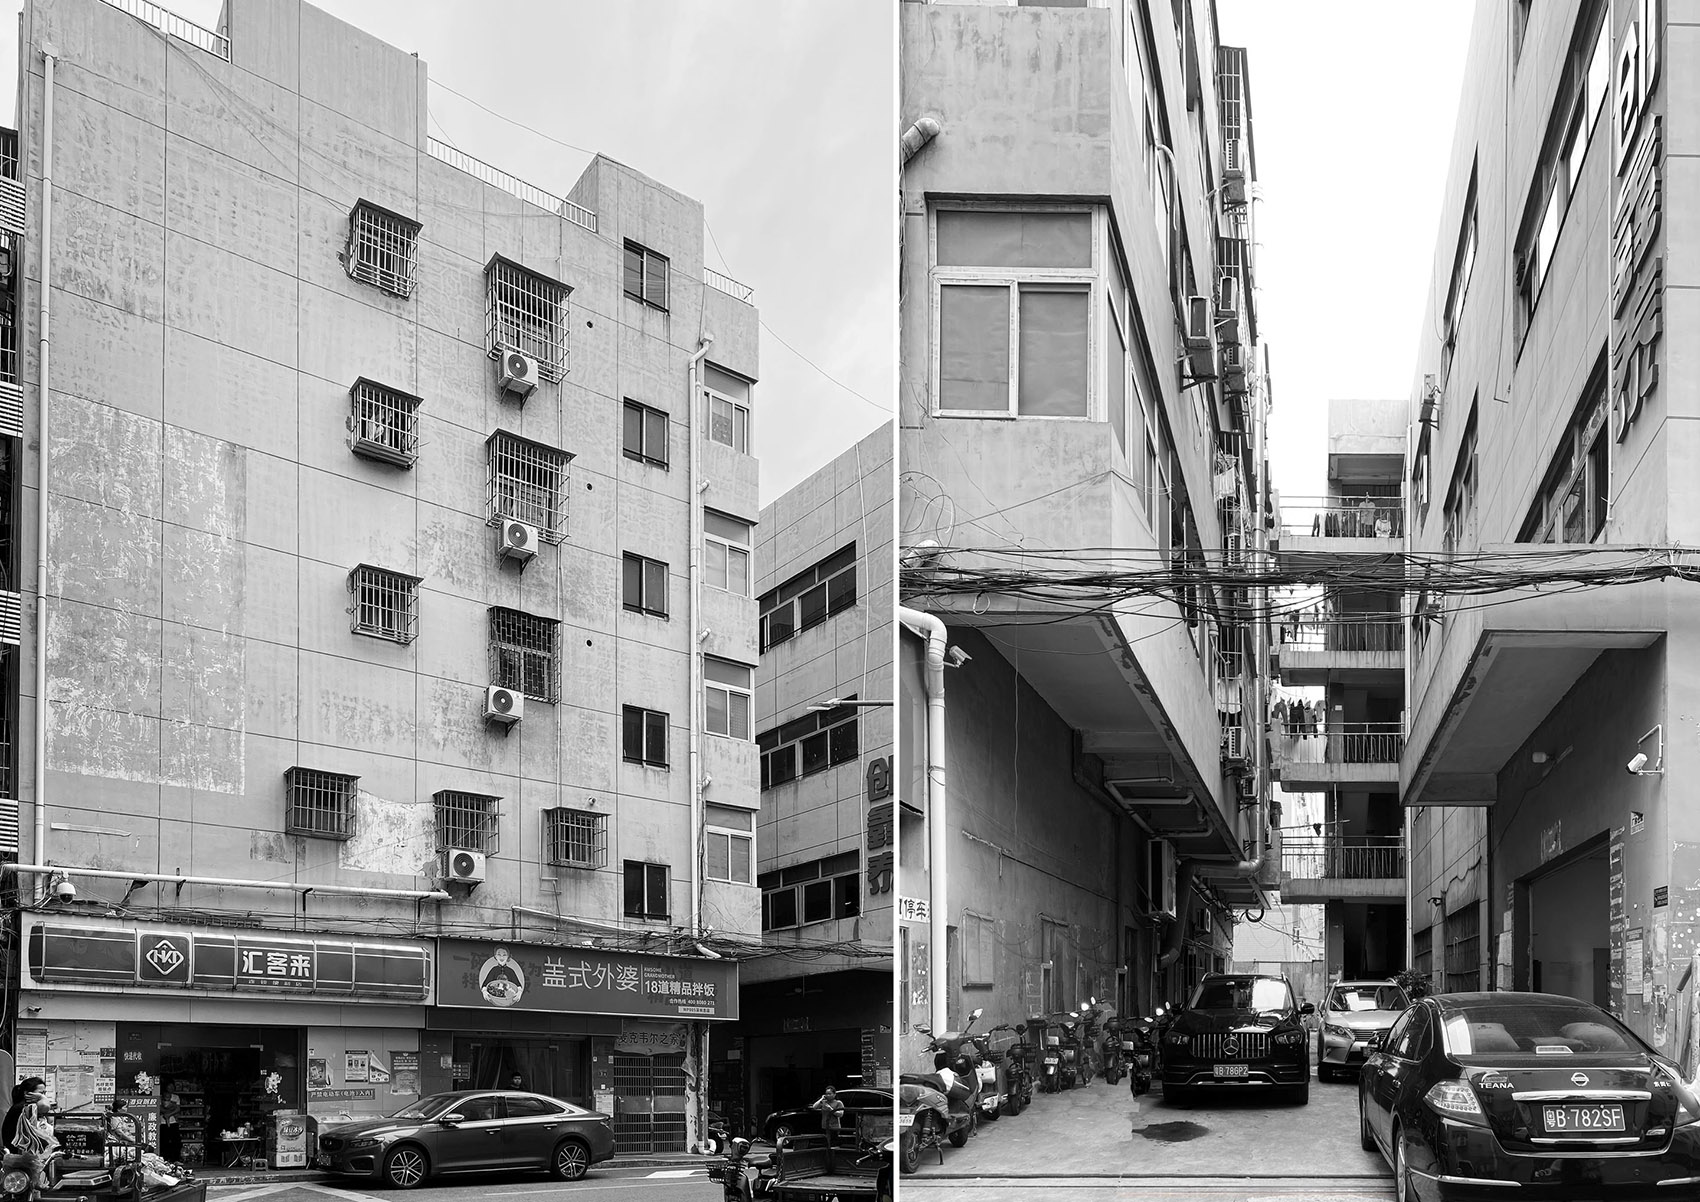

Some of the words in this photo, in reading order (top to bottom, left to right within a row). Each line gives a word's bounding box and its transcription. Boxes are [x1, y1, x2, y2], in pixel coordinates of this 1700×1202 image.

[242, 950, 311, 977] 汇客来
[542, 956, 639, 992] 盖式外婆
[645, 980, 715, 997] 18道精品拌饭
